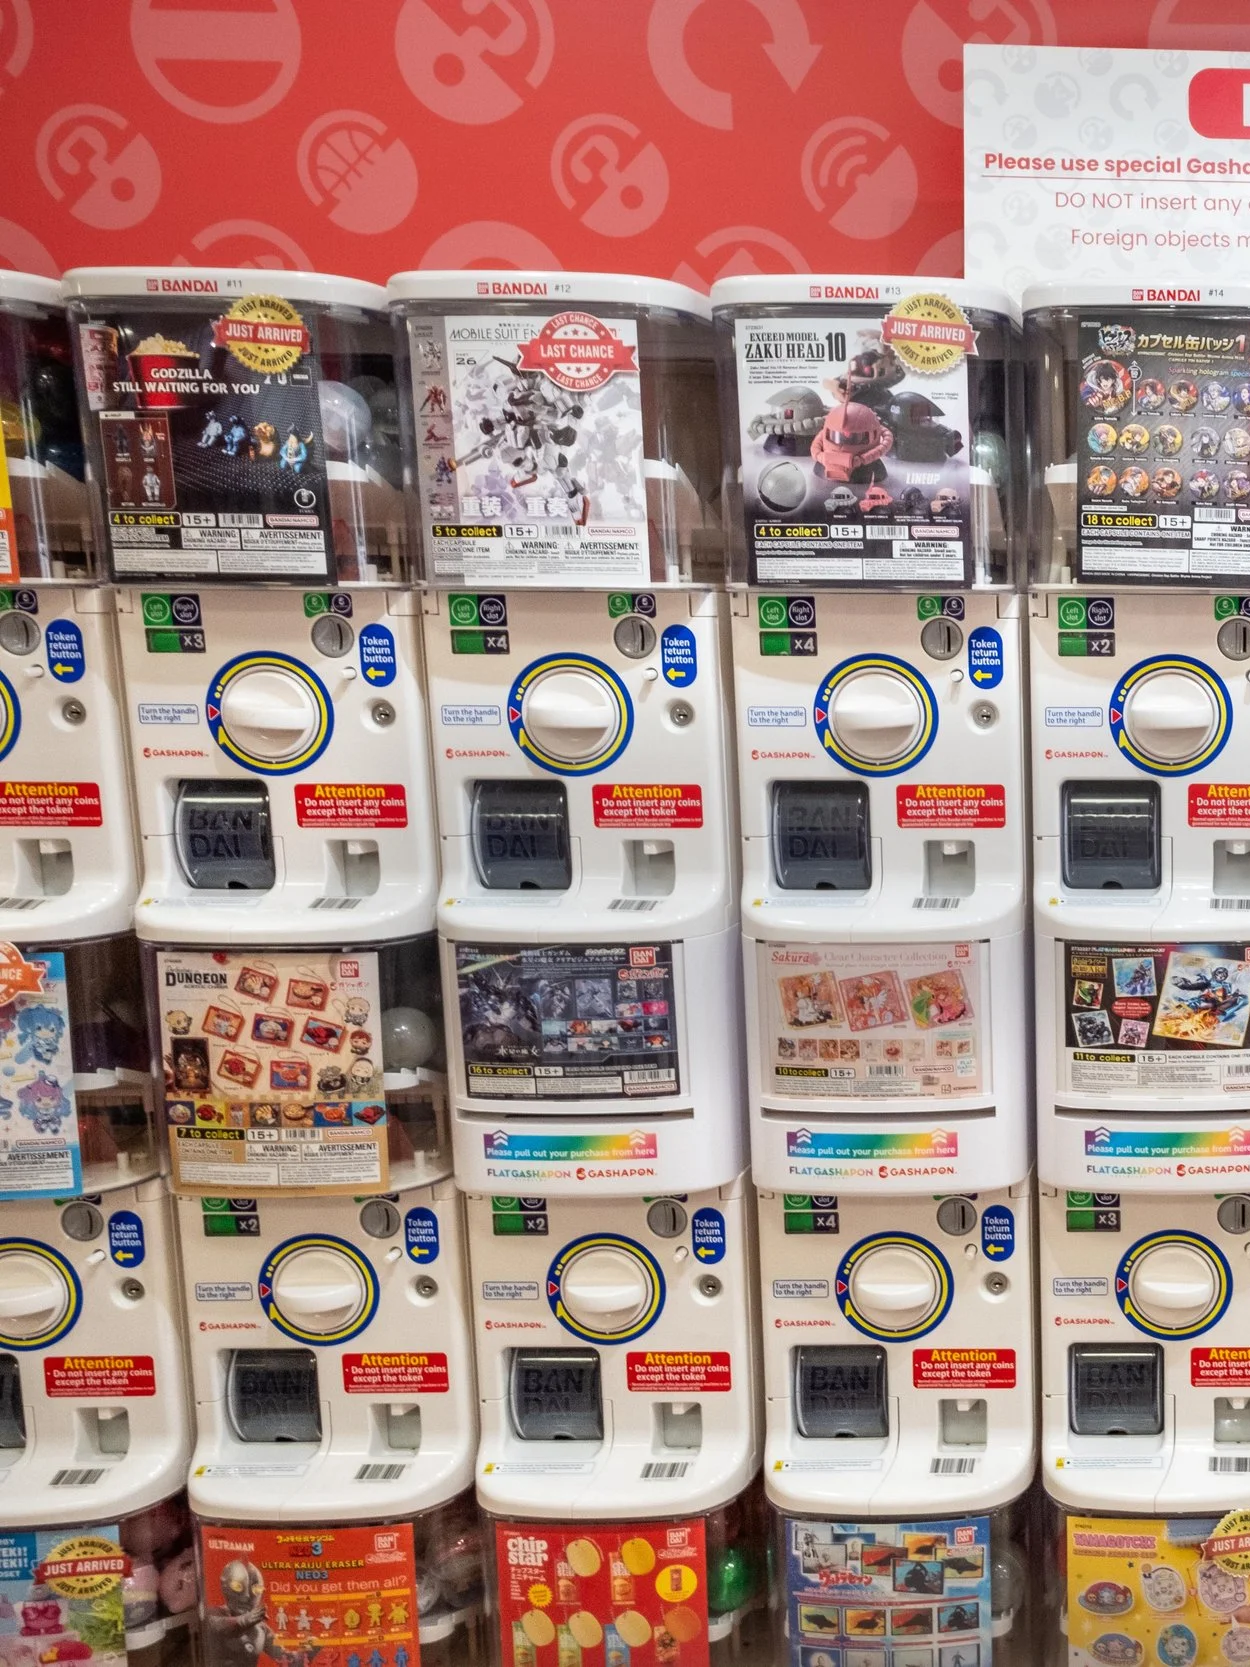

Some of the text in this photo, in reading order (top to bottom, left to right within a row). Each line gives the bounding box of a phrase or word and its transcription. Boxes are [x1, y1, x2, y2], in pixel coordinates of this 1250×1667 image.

[984, 152, 1055, 175] Please
[1060, 159, 1100, 175] use
[1105, 154, 1181, 180] special
[1055, 192, 1086, 209] DO
[1092, 193, 1133, 210] NOT
[1140, 192, 1198, 212] insert
[1204, 197, 1242, 216] any
[1071, 228, 1148, 252] Foreign
[1155, 229, 1229, 252] objects
[162, 280, 218, 292] BANDAI
[227, 280, 242, 288] #11
[493, 283, 547, 295] BANDAI
[825, 287, 878, 298] BANDAI
[885, 287, 900, 295] #13
[1148, 290, 1200, 301] BANDAI
[1209, 289, 1223, 297] #14
[226, 324, 302, 341] JUST ARRIVED
[450, 329, 491, 339] MOBILE
[495, 329, 518, 339] SUIT
[750, 333, 819, 342] EXCEED MODEL
[891, 321, 965, 342] JUST ARRIVED
[541, 344, 614, 358] LAST CHANCE
[745, 344, 825, 359] ZAKU HEAD
[826, 332, 846, 362] 10
[151, 368, 212, 379] GODZILLA
[1168, 367, 1198, 376] Sparkling
[1199, 368, 1229, 377] hologram
[113, 382, 259, 394] STILL WAITING FOR YOU
[1087, 515, 1152, 526] 18 to collect
[1163, 518, 1187, 526] 15+
[1197, 798, 1209, 806] Do
[1198, 808, 1227, 816] except
[772, 951, 810, 963] Sakura
[166, 972, 227, 987] DUNGEON
[1088, 1145, 1113, 1153] Please
[1116, 1145, 1132, 1155] pull
[1135, 1146, 1148, 1154] out
[1151, 1147, 1169, 1156] your
[1172, 1145, 1210, 1155] purchase
[1213, 1145, 1231, 1153] from
[209, 1540, 254, 1551] ULTRAMAN
[507, 1537, 548, 1552] chip
[1212, 1540, 1235, 1551] JUST
[508, 1550, 548, 1566] star
[44, 1560, 124, 1576] JUST ARRIVED
[271, 1576, 407, 1593] Did you get them all?
